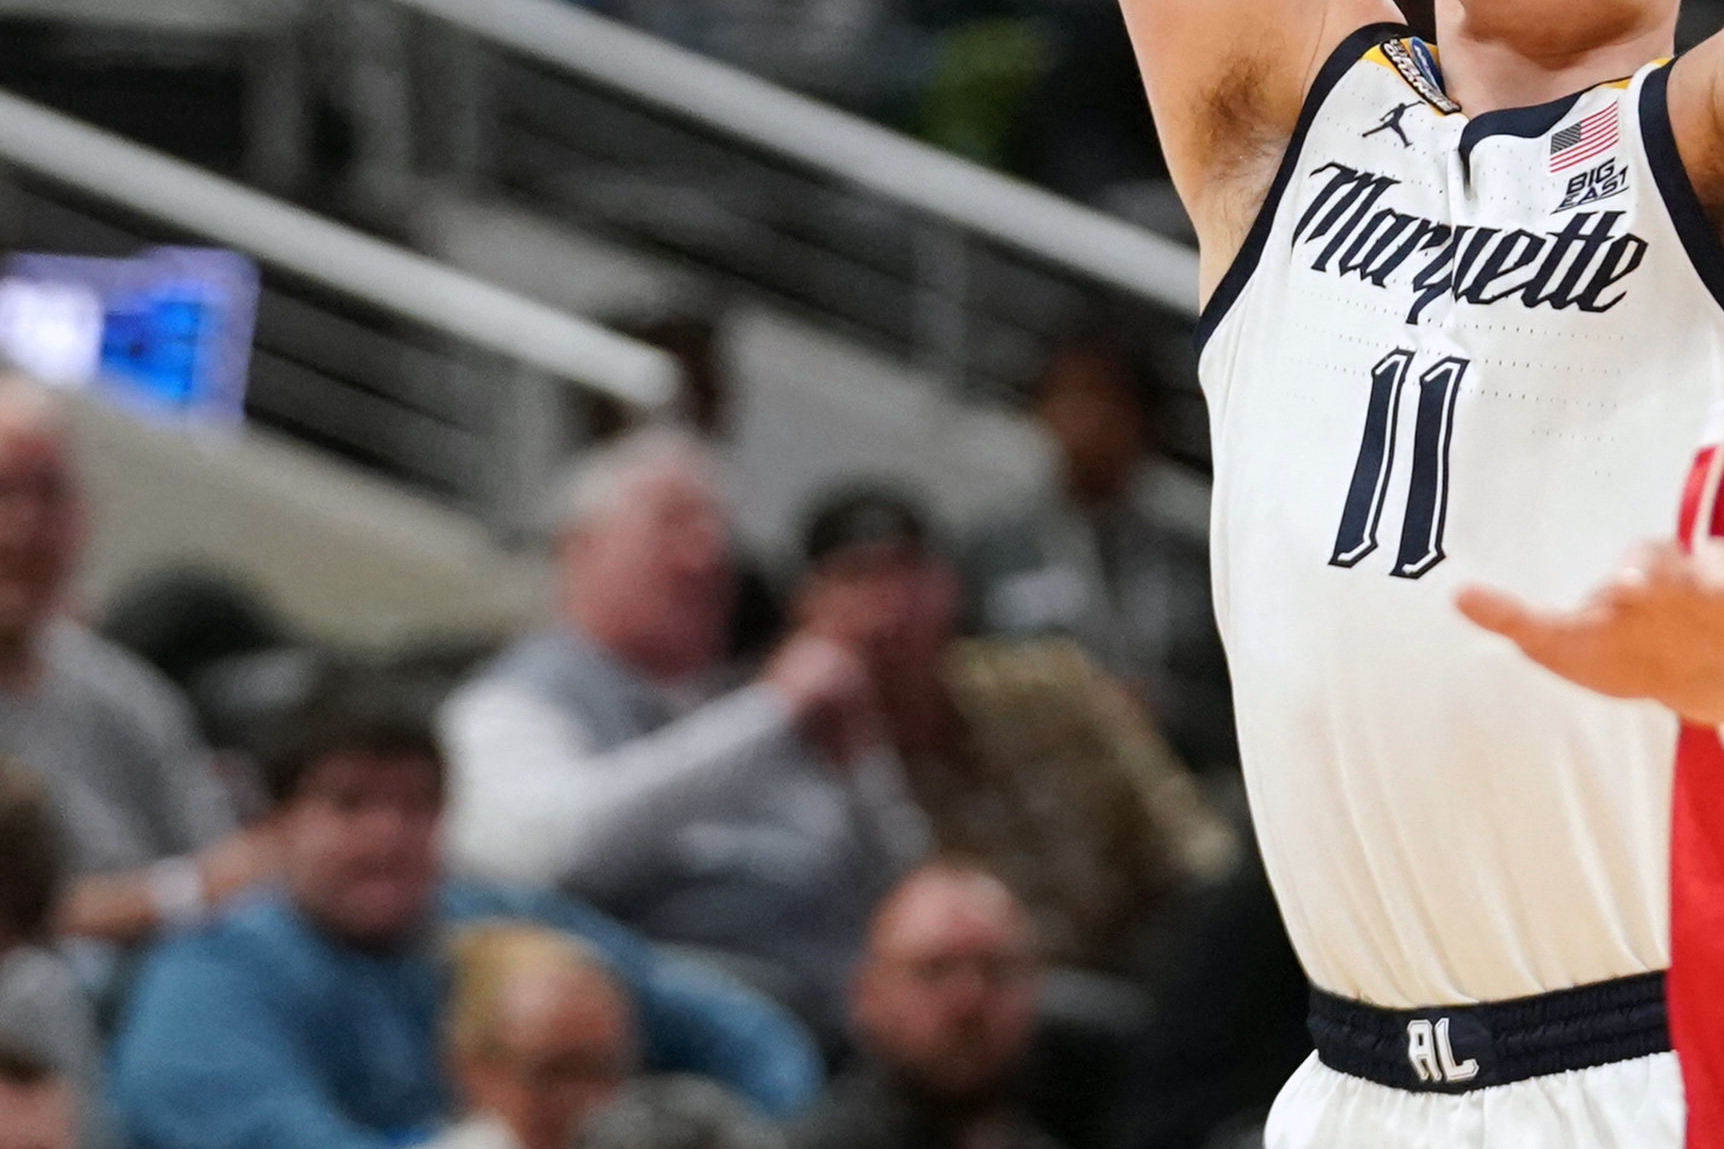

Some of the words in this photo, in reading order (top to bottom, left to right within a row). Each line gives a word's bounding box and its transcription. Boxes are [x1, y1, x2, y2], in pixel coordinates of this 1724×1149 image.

[1558, 165, 1629, 208] EAST
[1566, 157, 1616, 195] BIG
[1292, 162, 1649, 325] Marquette
[1328, 347, 1471, 580] 11
[1406, 1018, 1479, 1082] AL
